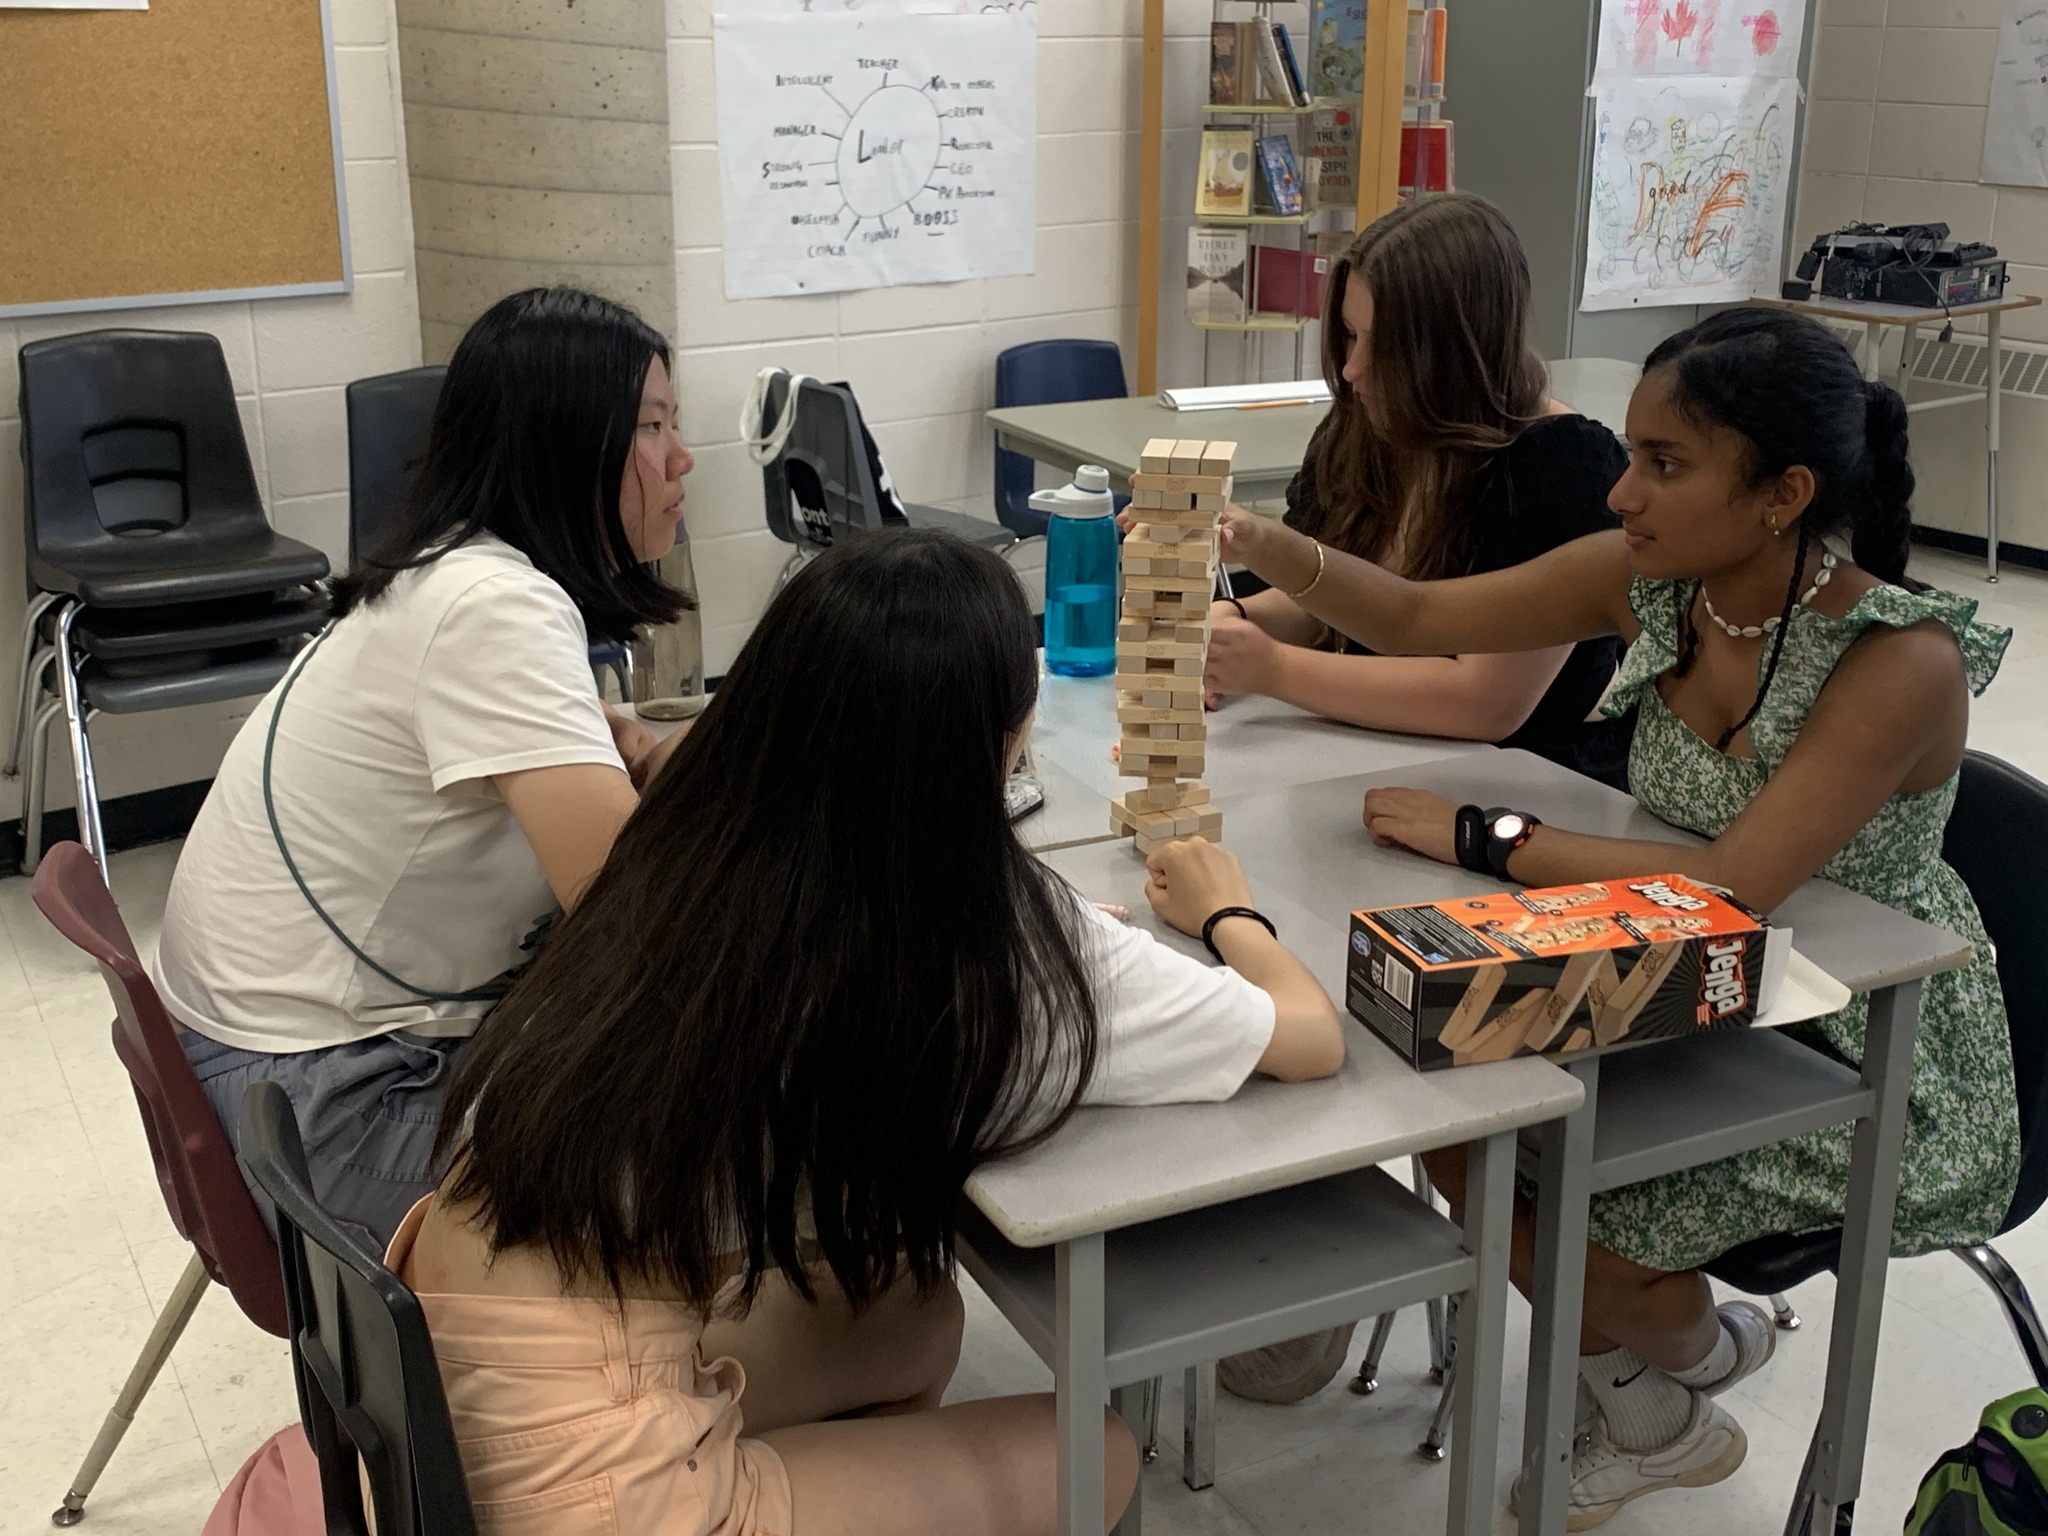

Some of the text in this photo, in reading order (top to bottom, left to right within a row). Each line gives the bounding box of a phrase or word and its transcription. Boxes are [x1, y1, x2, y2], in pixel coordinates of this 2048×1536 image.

[773, 124, 817, 138] MANAGER
[1315, 131, 1336, 143] THE
[950, 162, 973, 176] CEO
[1322, 161, 1347, 173] SEPH
[807, 244, 846, 259] COACH
[1628, 880, 1709, 911] Jenga
[1705, 940, 1746, 1015] Jenga
